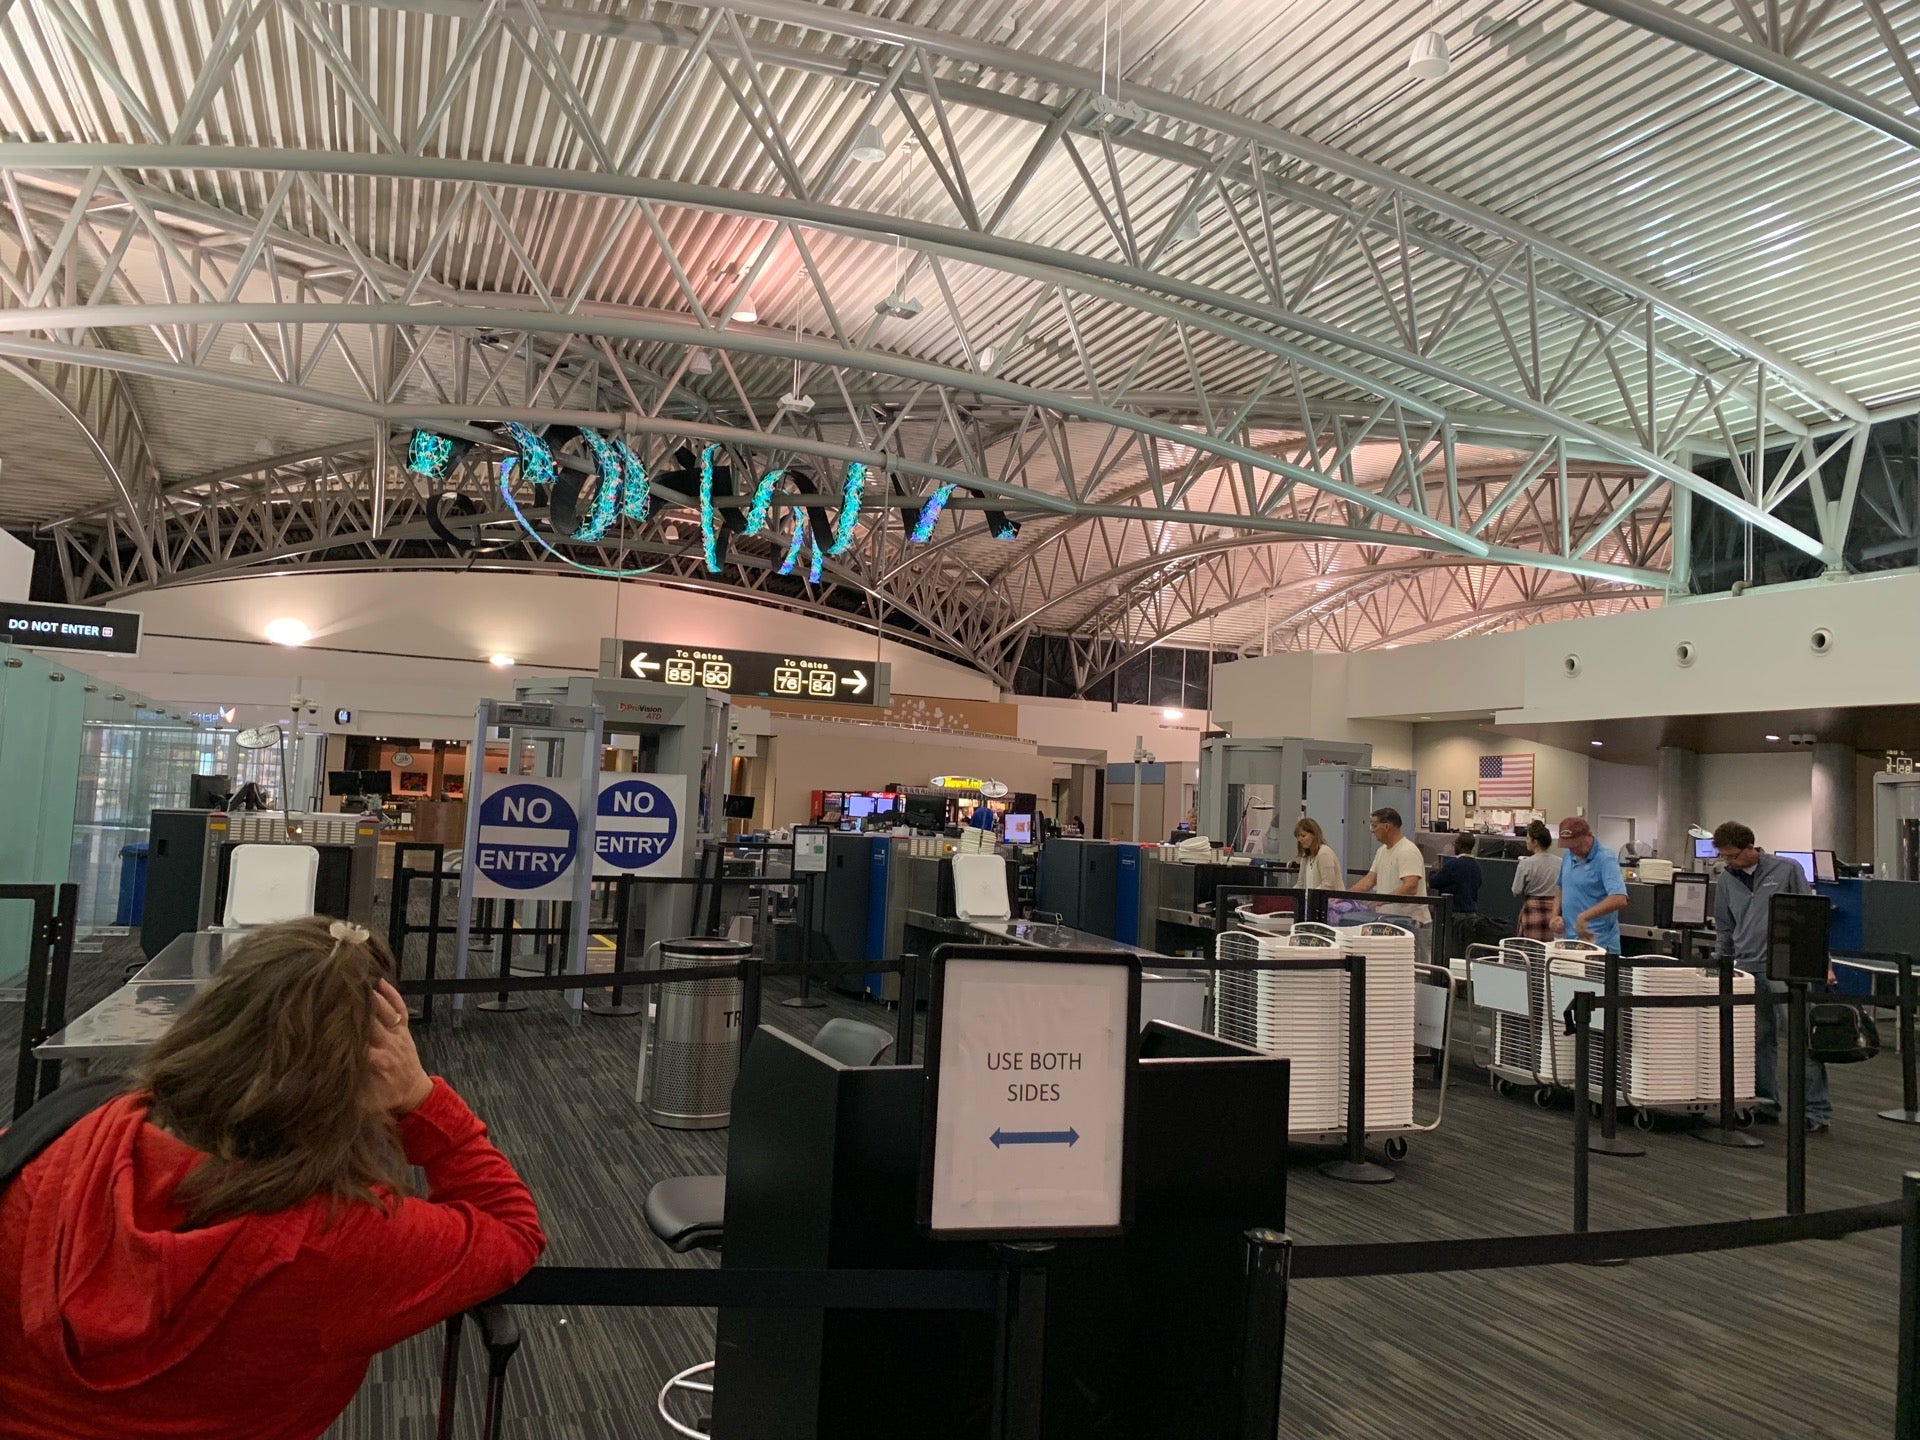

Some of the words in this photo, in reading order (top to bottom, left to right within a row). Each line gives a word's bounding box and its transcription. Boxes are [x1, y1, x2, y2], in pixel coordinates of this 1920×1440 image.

[8, 619, 29, 630] DO
[31, 621, 59, 632] NOT
[61, 624, 100, 636] ENTER
[676, 650, 689, 658] To
[693, 651, 723, 661] Gates
[784, 659, 796, 667] To
[800, 660, 828, 670] Gates
[669, 669, 691, 682] 85
[705, 672, 728, 685] 90
[778, 677, 798, 690] 76
[812, 680, 832, 693] 84
[626, 705, 662, 713] ProVision
[646, 712, 662, 720] ATD
[613, 791, 655, 814] NO
[502, 796, 552, 824] NO
[595, 836, 667, 855] ENTRY
[479, 850, 566, 873] ENTRY
[987, 1052, 1024, 1071] USE
[1030, 1052, 1082, 1071] BOTH
[1007, 1083, 1061, 1102] SIDES
